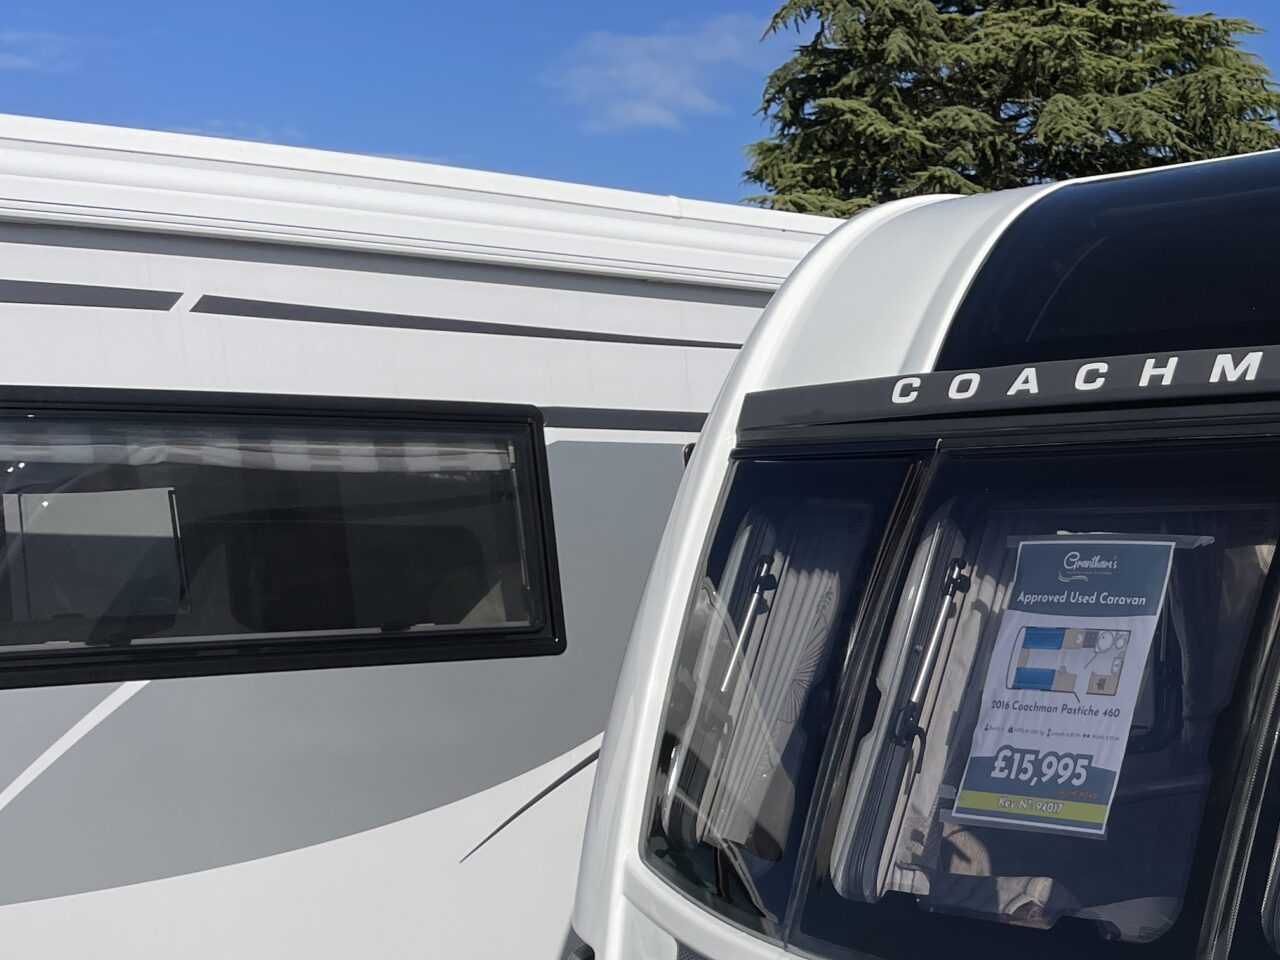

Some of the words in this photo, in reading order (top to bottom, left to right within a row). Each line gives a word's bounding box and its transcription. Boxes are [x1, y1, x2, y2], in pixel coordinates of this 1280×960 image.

[1063, 551, 1118, 570] Grantham's
[1017, 590, 1068, 605] Approved
[1070, 591, 1098, 604] Used
[1100, 592, 1146, 606] Caravan
[991, 700, 1010, 710] 2016
[1012, 700, 1058, 713] Coachman
[1061, 703, 1100, 717] Pastiche
[1102, 708, 1120, 718] 460
[990, 748, 1090, 787] £15,995
[998, 796, 1016, 809] Key
[1036, 802, 1064, 814] 94017
